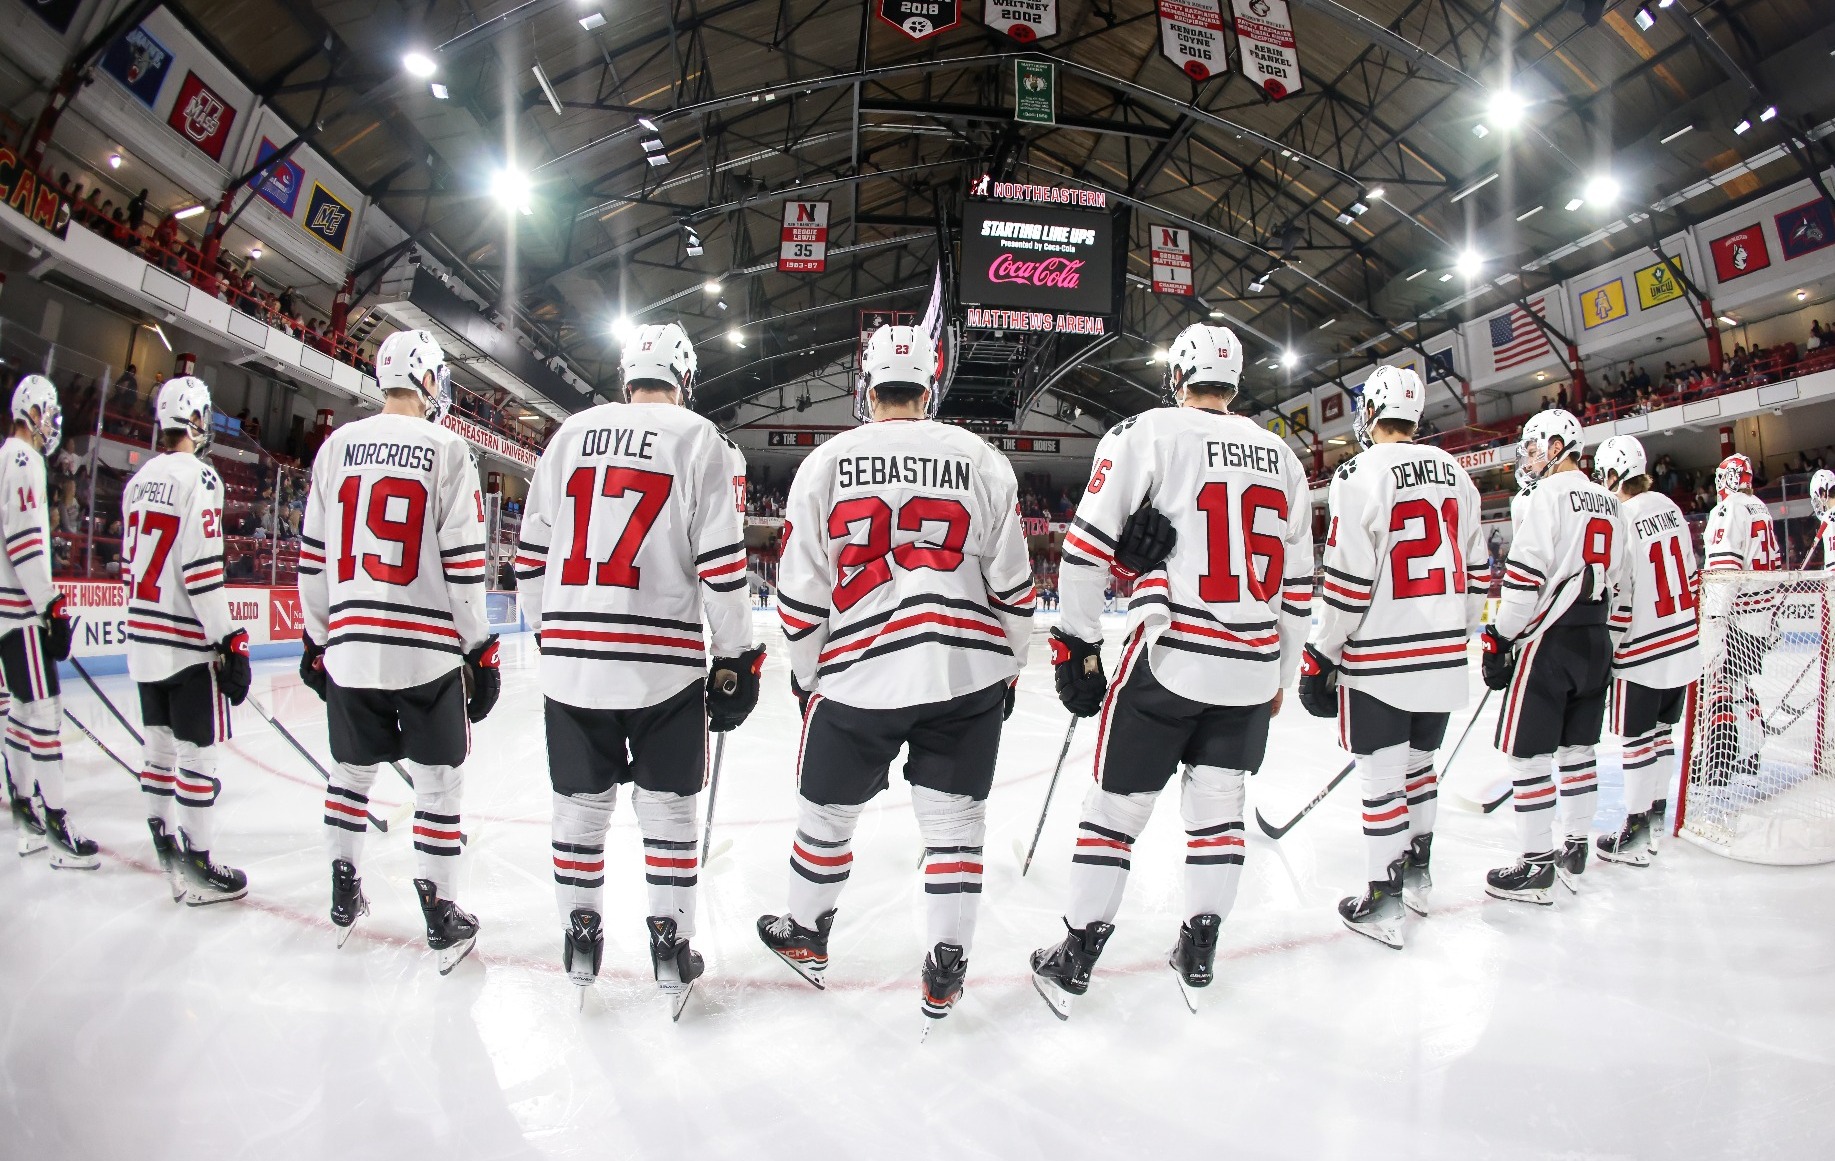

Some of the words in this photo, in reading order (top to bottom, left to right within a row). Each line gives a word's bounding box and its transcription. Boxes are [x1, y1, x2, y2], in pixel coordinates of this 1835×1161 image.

[900, 3, 939, 15] 2018
[993, 0, 1049, 12] WHITNEY
[1001, 9, 1042, 24] 2002
[1170, 23, 1216, 41] KENDALL
[1177, 33, 1211, 47] COYNE
[1179, 43, 1212, 60] 2016
[1249, 48, 1292, 67] FRANKEL
[1254, 43, 1283, 57] AERIN
[1258, 61, 1288, 79] 2021
[993, 181, 1106, 208] NORTHEASTERN
[797, 203, 817, 222] N
[980, 219, 1042, 240] STARTING
[1041, 225, 1070, 243] LINE
[1069, 227, 1096, 245] UPS
[1161, 228, 1179, 248] N
[793, 243, 813, 258] 35
[1000, 239, 1033, 250] Presented
[1033, 241, 1043, 251] by
[1043, 242, 1076, 253] Coca-Cola
[967, 308, 1053, 331] MATTHEWS
[1056, 315, 1105, 335] ARENA
[895, 344, 910, 355] 23
[581, 427, 659, 460] DOYLE
[782, 433, 797, 445] THE
[1002, 438, 1016, 450] THE
[1033, 440, 1057, 452] HOUSE
[343, 442, 436, 473] NORCROSS
[501, 441, 538, 468] UNIVERSITY
[1206, 440, 1280, 475] FISHER
[838, 455, 971, 491] SEBASTIAN
[1390, 459, 1457, 490] DEMELIS
[337, 474, 429, 587] 19
[560, 464, 675, 590] 17
[1634, 510, 1680, 540] FONTAINE
[1196, 481, 1289, 603] 16
[1389, 497, 1466, 601] 21
[1648, 535, 1695, 619] 11
[80, 585, 124, 607] HUSKIES
[228, 601, 259, 620] RADIO
[273, 600, 295, 631] N
[1301, 787, 1329, 817] CCM
